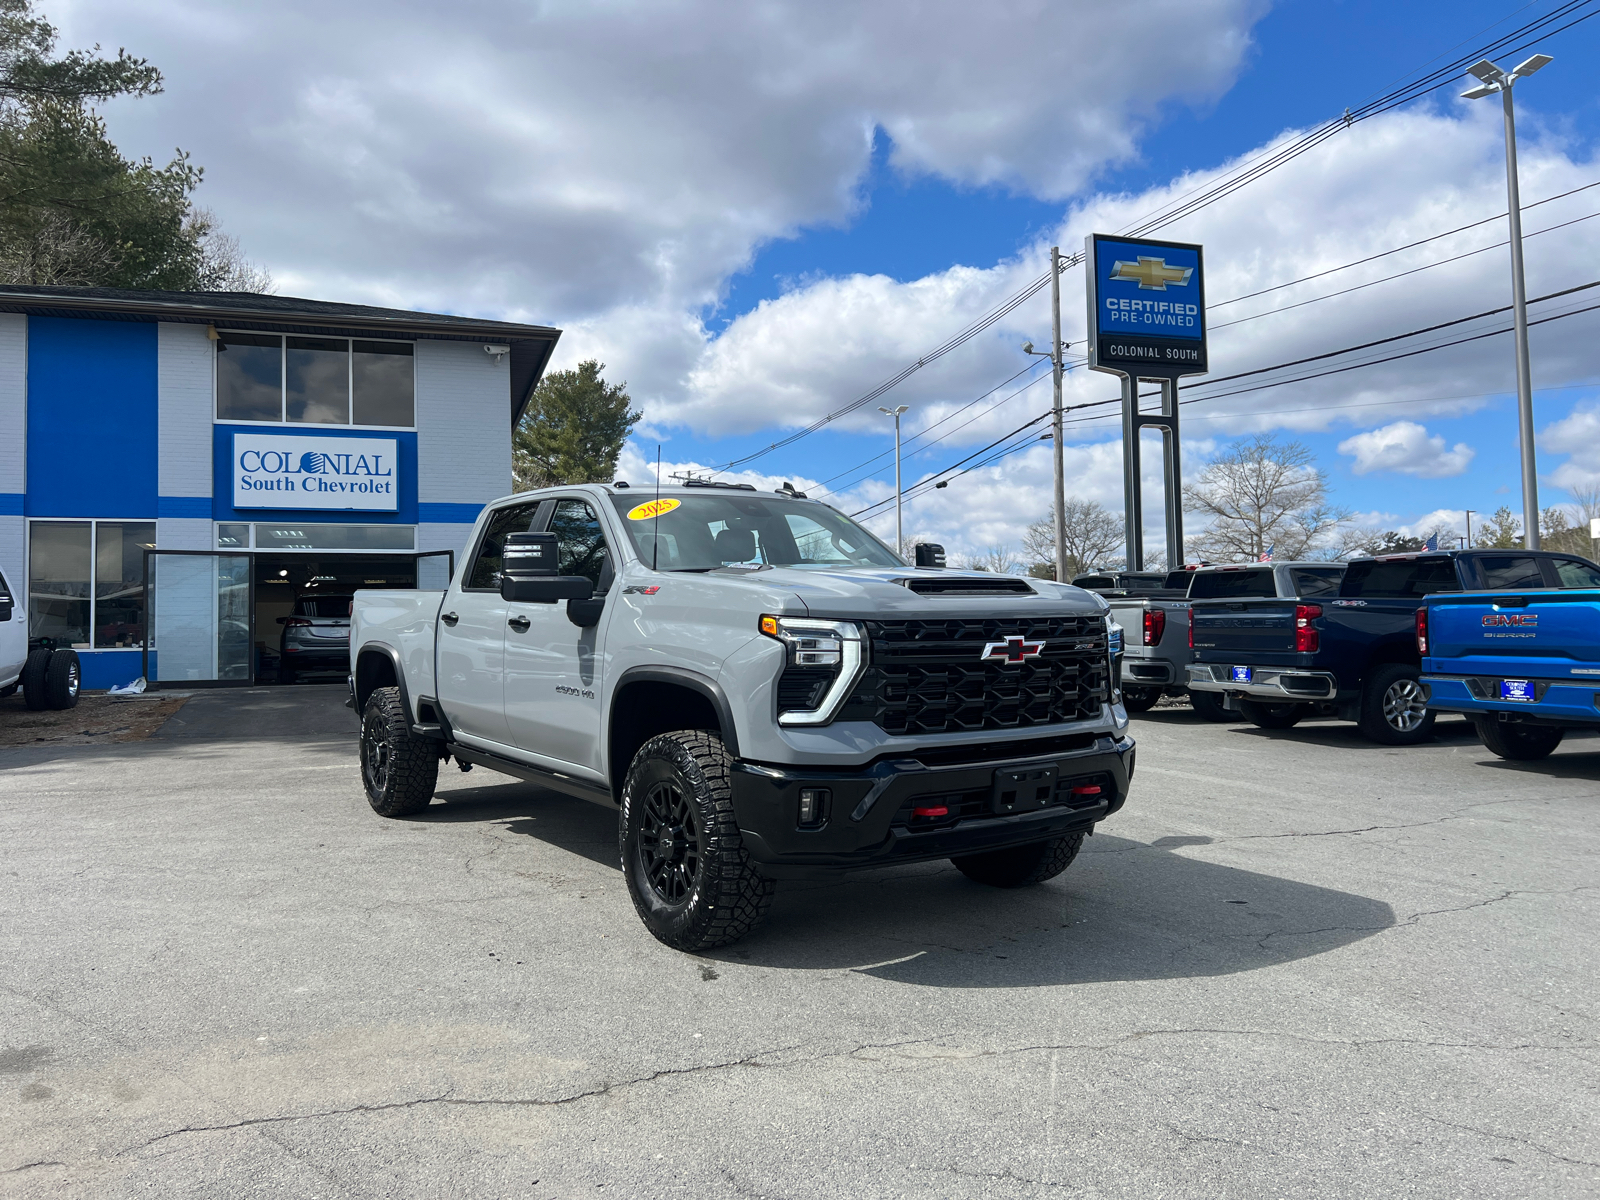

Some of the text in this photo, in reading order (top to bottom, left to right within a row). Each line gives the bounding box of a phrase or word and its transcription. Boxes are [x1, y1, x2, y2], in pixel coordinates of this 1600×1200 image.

[1106, 298, 1198, 315] CERTIFIED
[1111, 311, 1194, 326] PRE-OWNED
[1110, 345, 1198, 360] COLONIAL SOUTH
[240, 450, 392, 476] COLONIAL
[241, 475, 391, 494] South Chevrolet
[638, 500, 673, 517] 2025
[1482, 614, 1538, 627] GMC
